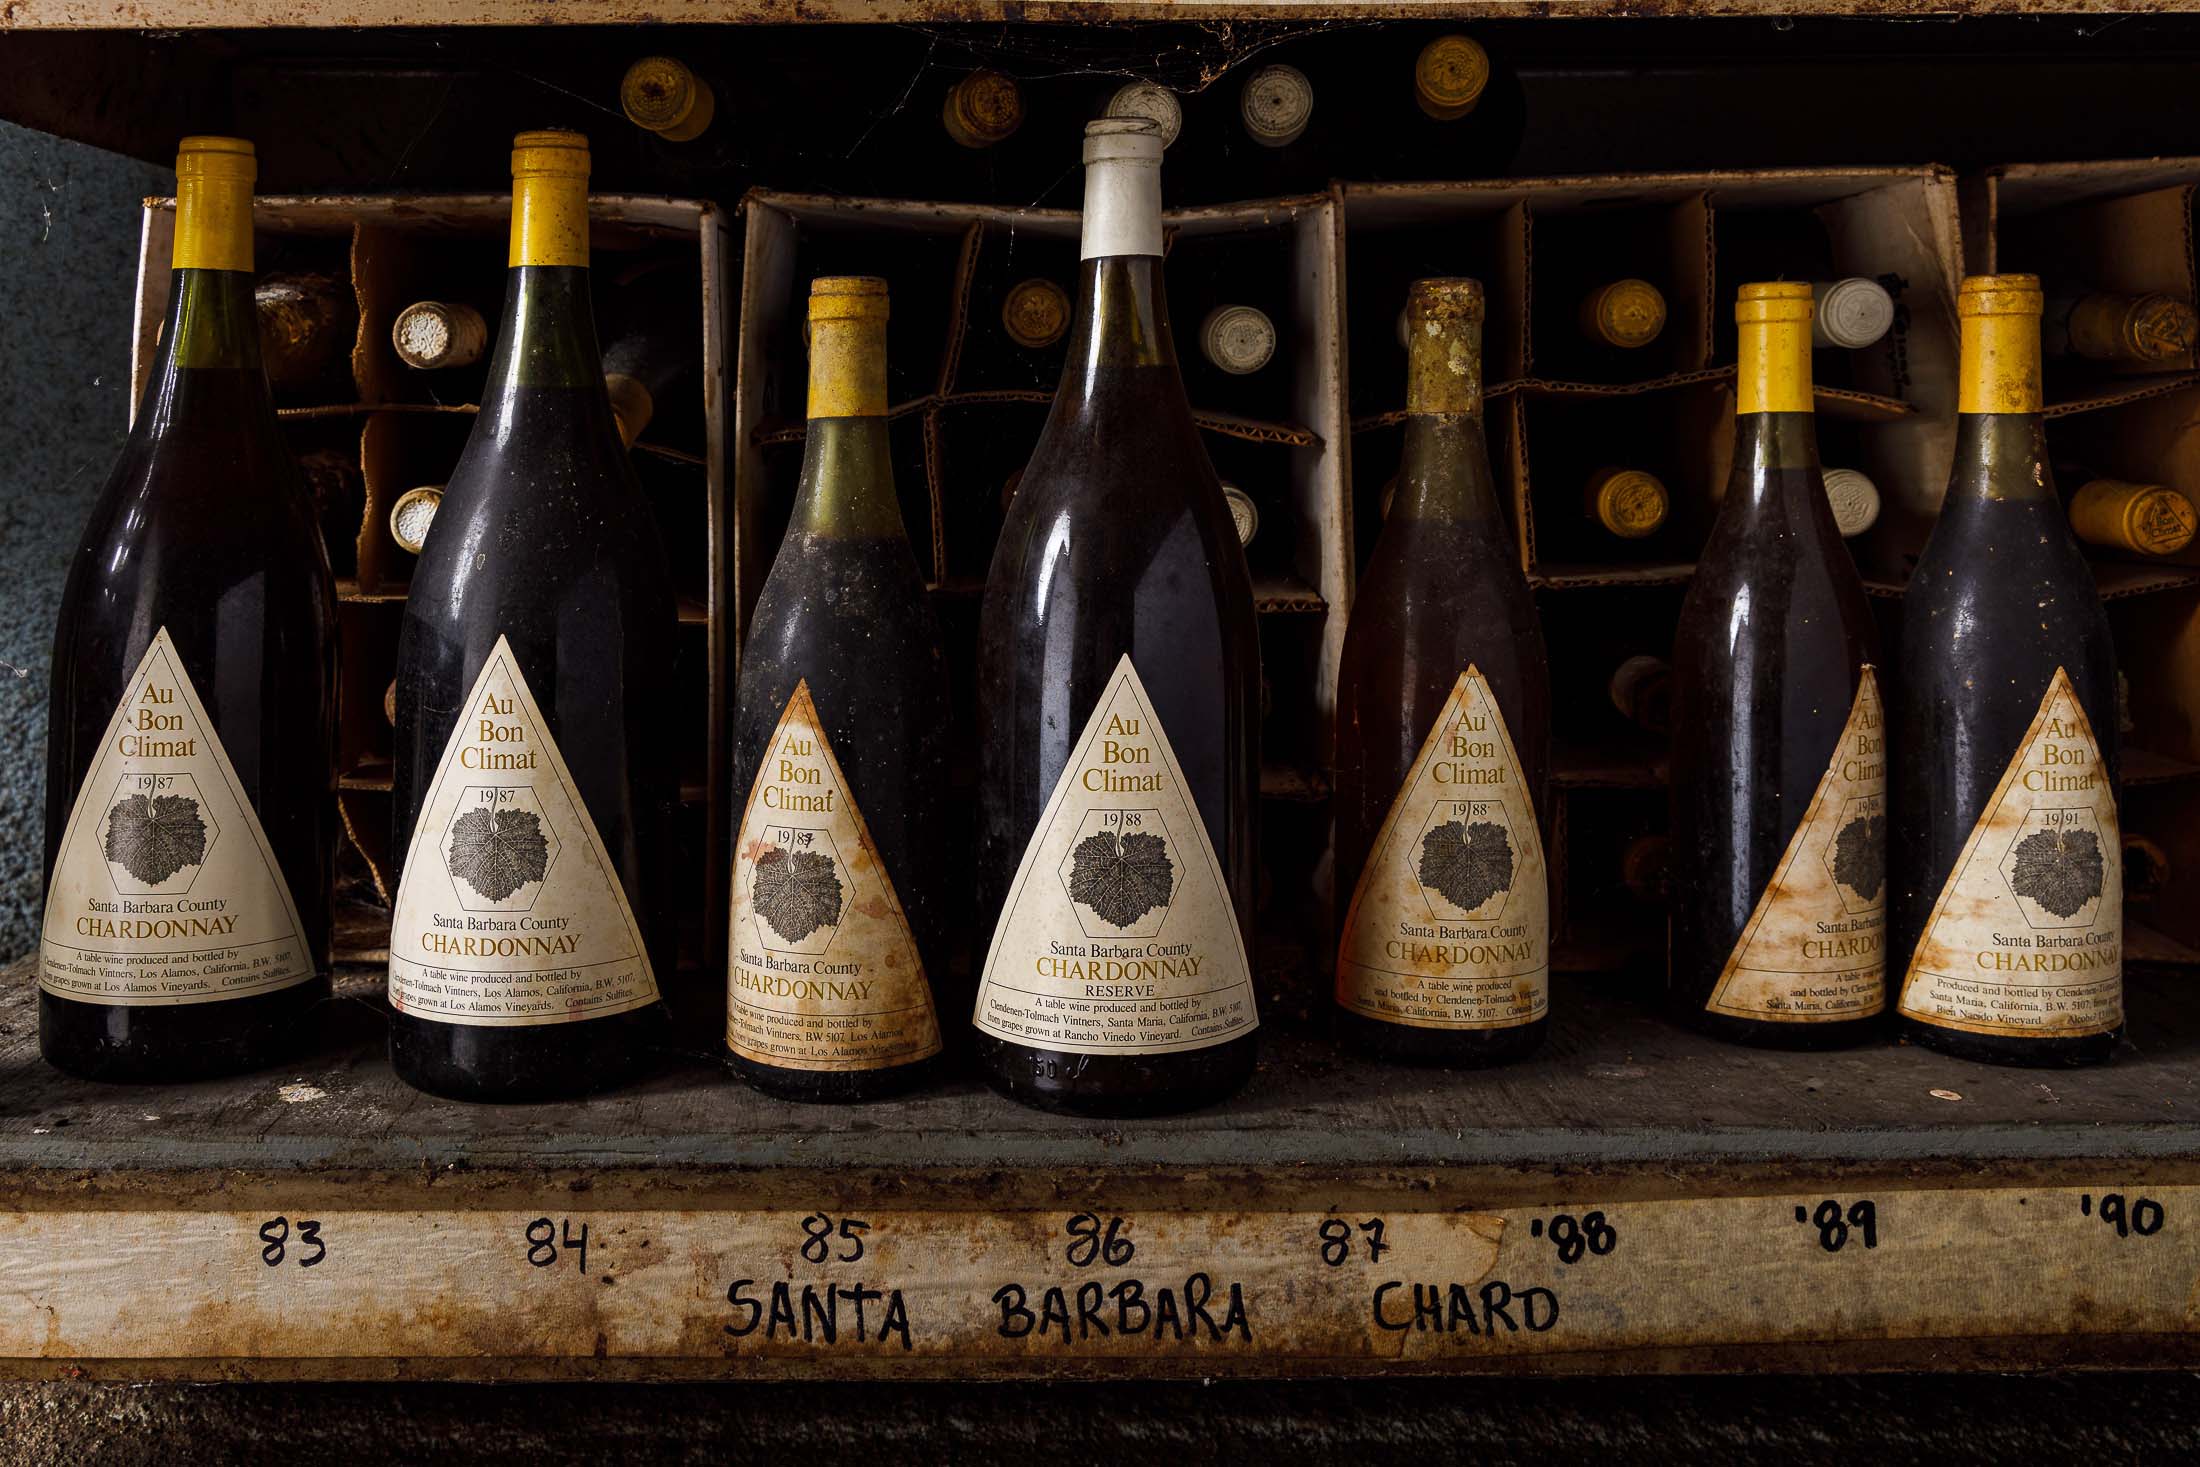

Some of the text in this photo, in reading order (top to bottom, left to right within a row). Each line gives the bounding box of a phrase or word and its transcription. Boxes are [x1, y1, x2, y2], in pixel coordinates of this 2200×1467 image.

[139, 682, 174, 704] Au
[481, 692, 514, 715] Au
[137, 708, 184, 731] Bon
[1105, 713, 1141, 735] Au
[1455, 709, 1487, 732] Au
[2045, 717, 2076, 739] Au
[479, 720, 524, 742] Bon
[118, 735, 197, 757] Climat
[781, 733, 812, 756] Au
[1101, 741, 1151, 764] Bon
[1451, 736, 1496, 758] Bon
[2042, 743, 2085, 765] Bon
[460, 747, 537, 770] Climat
[137, 777, 174, 789] 1987
[778, 760, 821, 784] Bon
[1082, 768, 1164, 792] Climat
[1432, 761, 1505, 785] Climat
[2022, 769, 2096, 792] Climat
[480, 790, 515, 802] 1987
[763, 785, 834, 813] Climat
[1104, 813, 1142, 827] 1988
[1453, 804, 1487, 816] 1988
[2045, 813, 2079, 826] 1991
[88, 898, 227, 914] Santa Barbara County
[77, 915, 240, 939] CHARDONNAY
[433, 913, 569, 931] Santa Barbara County
[1400, 922, 1528, 940] Santa Barbara County
[1816, 921, 1848, 934] Santa
[422, 933, 582, 957] CHARDONNAY
[1050, 941, 1192, 958] Santa Barbara County
[1992, 931, 2114, 948] Santa Barbara County
[76, 950, 239, 966] A table wine produced and bottled by
[740, 948, 862, 976] Santa Barbara County
[1386, 939, 1534, 965] CHARDONNAY
[1976, 944, 2119, 972] CHARDONNAY
[99, 967, 158, 979] Vintners, Los
[422, 968, 582, 985] A table wine produced and bottled by
[1036, 956, 1203, 981] CHARDONNAY
[71, 972, 259, 992] grown at Los Alamos Vineyards. Contains
[444, 985, 481, 998] Vintners,
[484, 988, 502, 998] Los
[734, 966, 874, 1001] CHARDONNAY
[1085, 985, 1155, 997] RESERVE
[1417, 979, 1512, 993] A table wine produced
[1790, 987, 1806, 997] and
[1809, 987, 1837, 997] bottled
[1839, 987, 1849, 996] by
[1937, 978, 1979, 993] Produced
[1982, 987, 2000, 995] and
[2004, 987, 2038, 998] bottled
[2042, 988, 2053, 1000] by
[418, 993, 603, 1013] grown at Los Alamos Vineyards. Contains
[1035, 997, 1202, 1014] A table wine produced and bottled by
[1390, 988, 1418, 1002] bottled
[1421, 993, 1433, 1005] by
[1766, 996, 1791, 1010] Santa
[1929, 990, 1953, 1002] Santa
[2046, 1001, 2068, 1012] B.W.
[750, 1010, 764, 1021] wine
[766, 1015, 804, 1027] produced
[807, 1019, 823, 1028] and
[827, 1018, 858, 1029] bottled
[862, 1018, 873, 1029] by
[1063, 1014, 1104, 1028] Vintners,
[1107, 1017, 1134, 1028] Santa
[1137, 1016, 1166, 1028] Maria,
[1454, 1008, 1474, 1019] B.W.
[850, 1031, 867, 1041] Los
[1001, 1019, 1023, 1032] grapes
[1025, 1025, 1050, 1037] grown
[1052, 1029, 1061, 1038] at
[1064, 1029, 1099, 1041] Rancho
[1102, 1032, 1136, 1042] Vinedo
[1191, 1023, 1223, 1037] Contains
[770, 1042, 796, 1054] grown
[798, 1047, 806, 1055] at
[811, 1046, 828, 1057] Los
[258, 1193, 2164, 1274] 83 84 85 86 87 '88 '89 '90
[722, 1271, 1560, 1350] SANTA BARBARA CHARD
